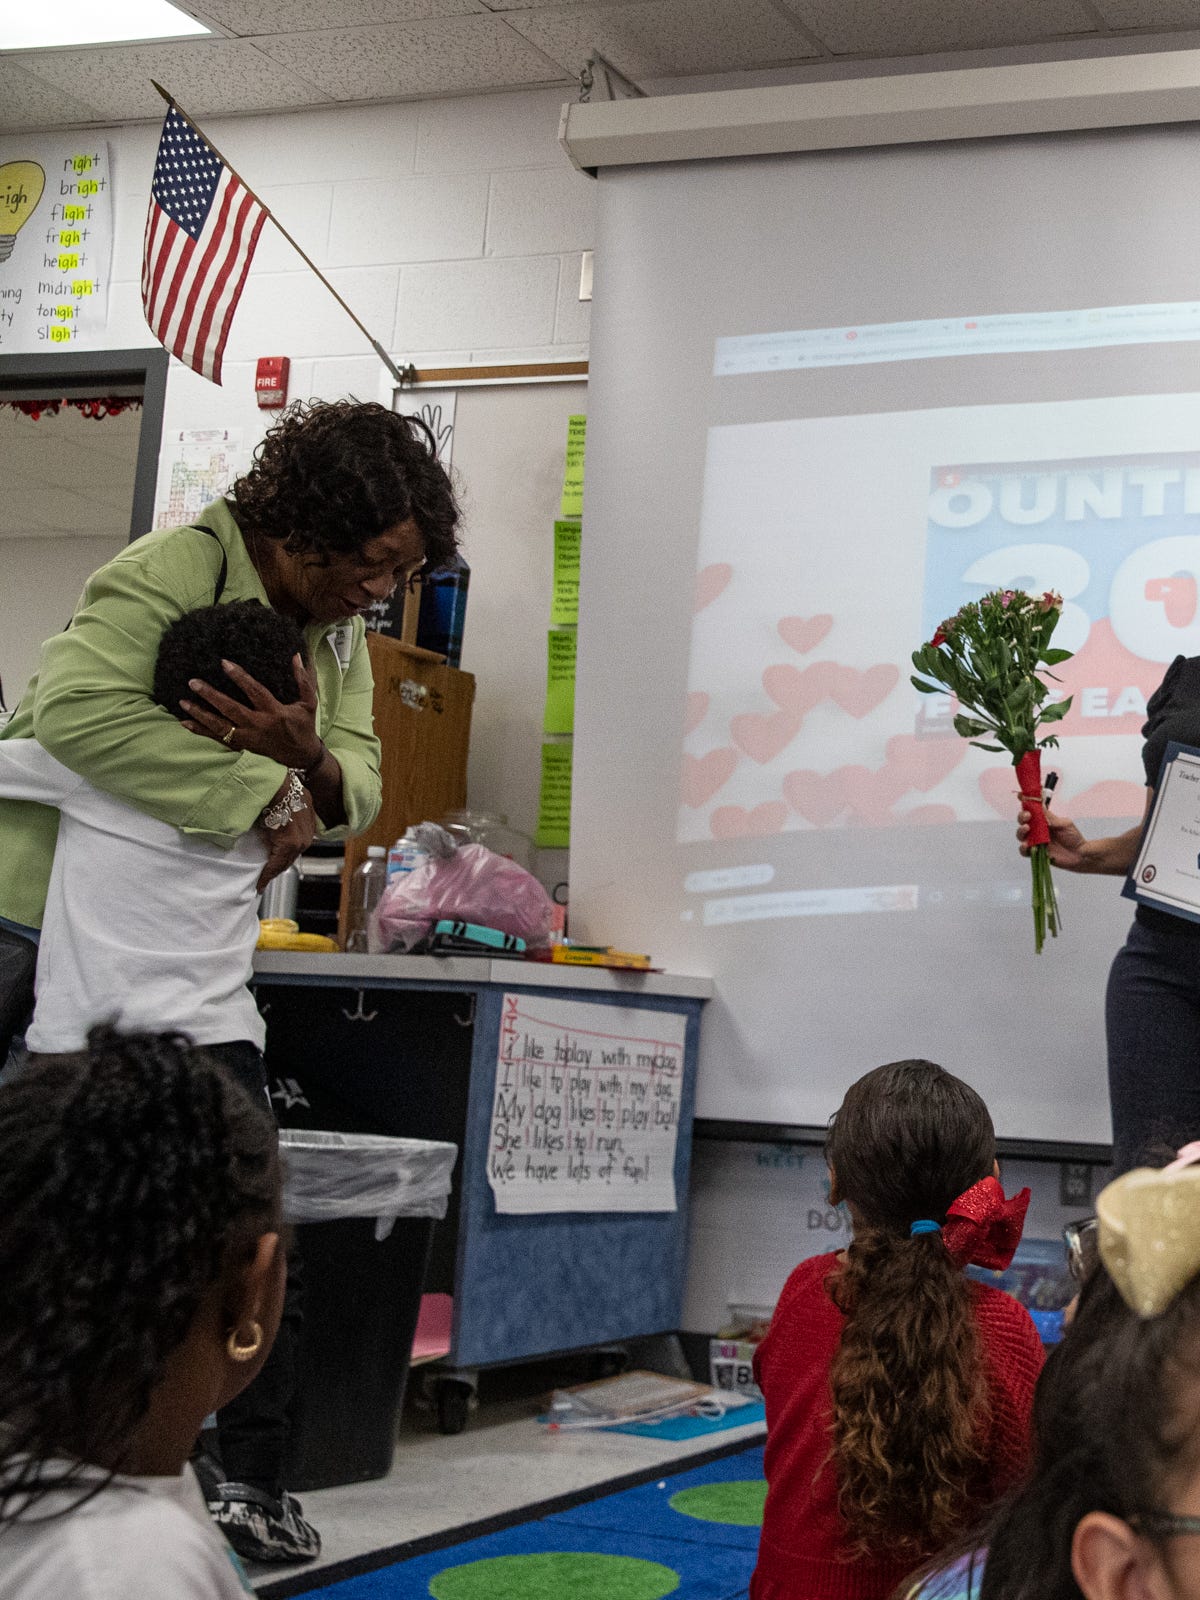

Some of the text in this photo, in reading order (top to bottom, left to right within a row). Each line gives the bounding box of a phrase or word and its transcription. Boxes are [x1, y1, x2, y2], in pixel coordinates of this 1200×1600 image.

[63, 153, 101, 176] right
[60, 178, 107, 198] bright
[51, 203, 94, 226] flight
[46, 227, 90, 248] fright
[43, 252, 88, 273] height
[38, 277, 101, 300] midnight
[37, 303, 80, 322] tonight
[257, 377, 277, 387] FIRE
[1179, 769, 1200, 783] Teacher
[501, 1062, 514, 1086] I
[496, 1093, 526, 1127] My
[534, 1098, 561, 1129] dog
[601, 1100, 615, 1121] to
[494, 1123, 521, 1151] She
[534, 1125, 564, 1151] likes
[491, 1154, 516, 1179] We
[525, 1154, 558, 1179] have
[567, 1155, 592, 1180] lots
[599, 1156, 617, 1178] of
